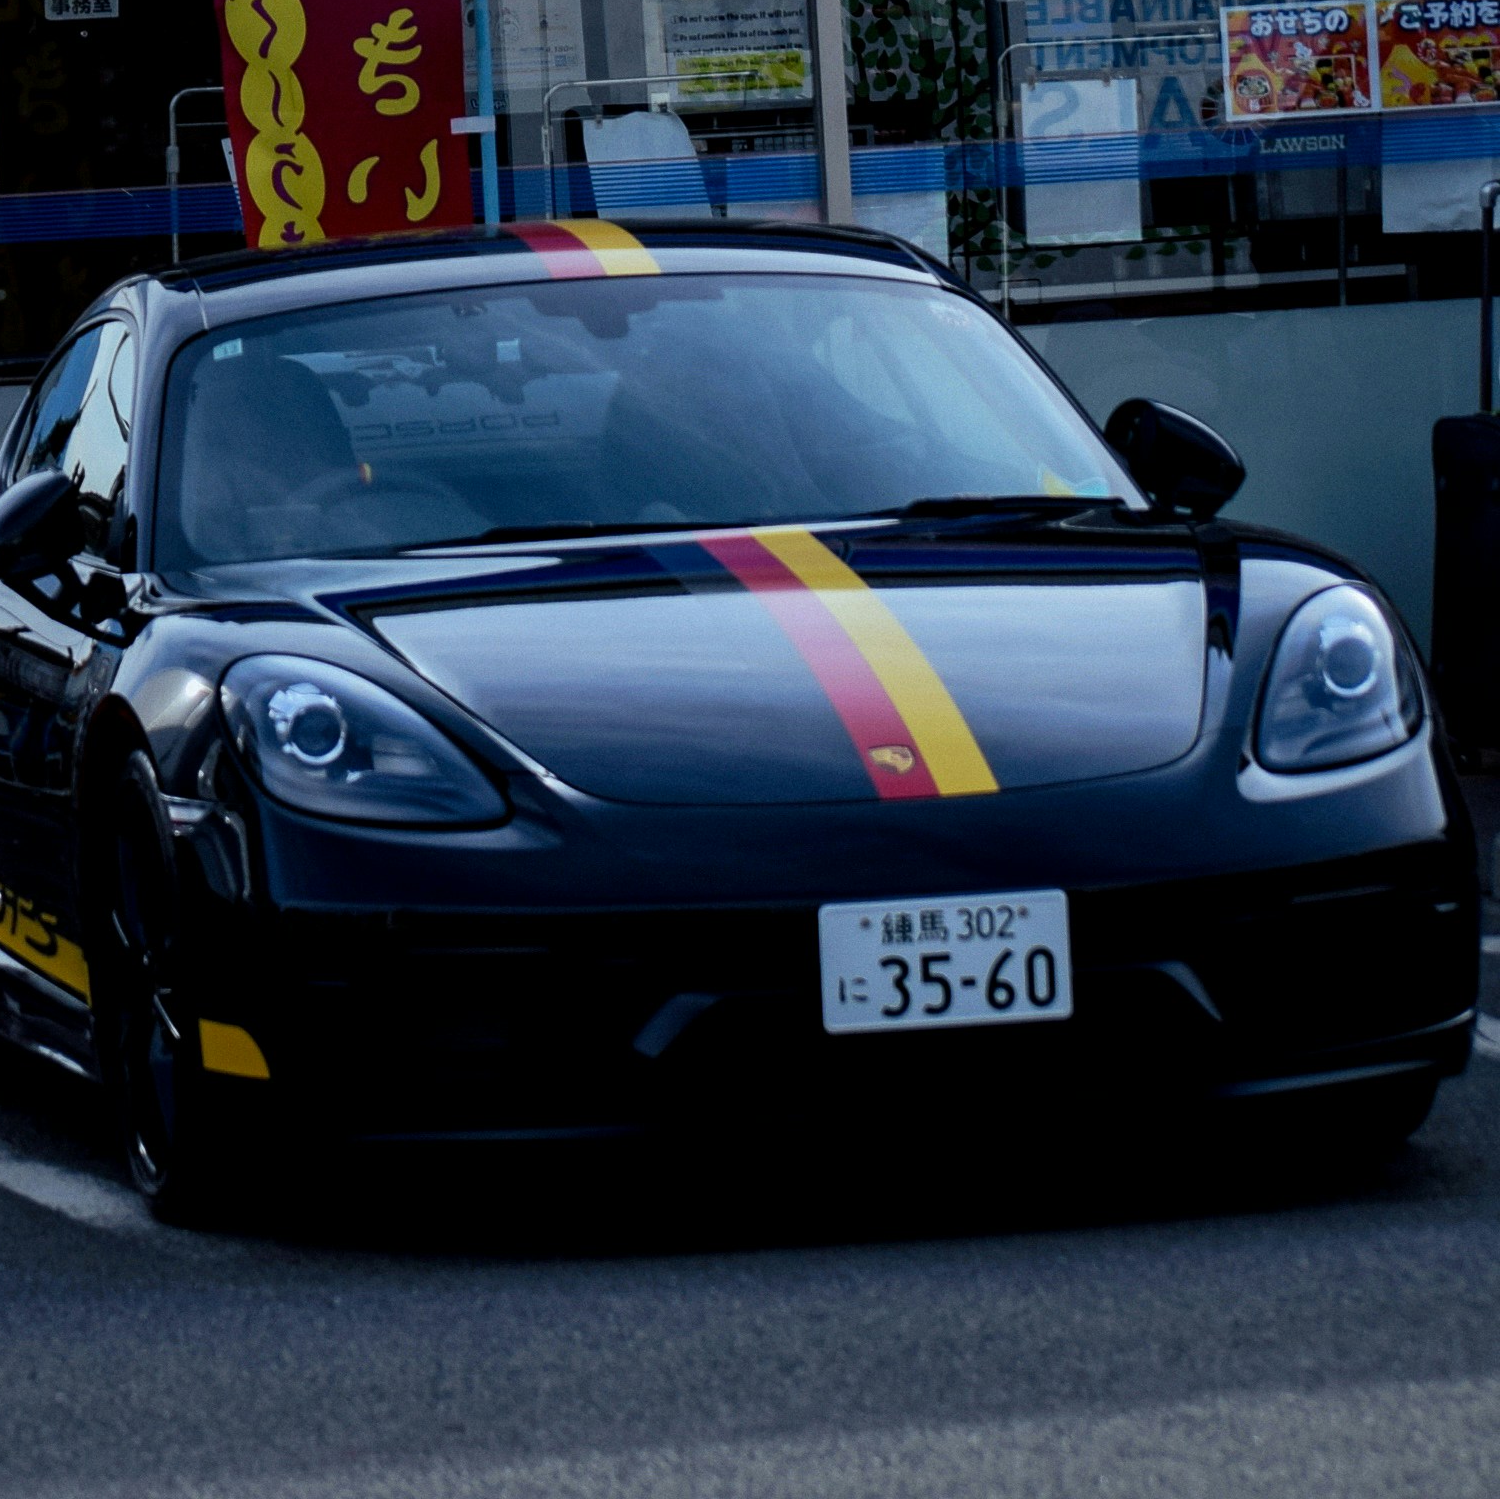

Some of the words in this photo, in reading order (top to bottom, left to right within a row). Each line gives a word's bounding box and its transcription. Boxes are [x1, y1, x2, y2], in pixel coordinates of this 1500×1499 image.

[1250, 7, 1350, 38] おせちの
[1400, 0, 1500, 30] ご予約を
[1260, 134, 1346, 154] LAWSON
[881, 907, 949, 945] 練馬
[955, 904, 1016, 941] 302
[837, 974, 869, 1005] に
[879, 943, 1057, 1017] 35-60
